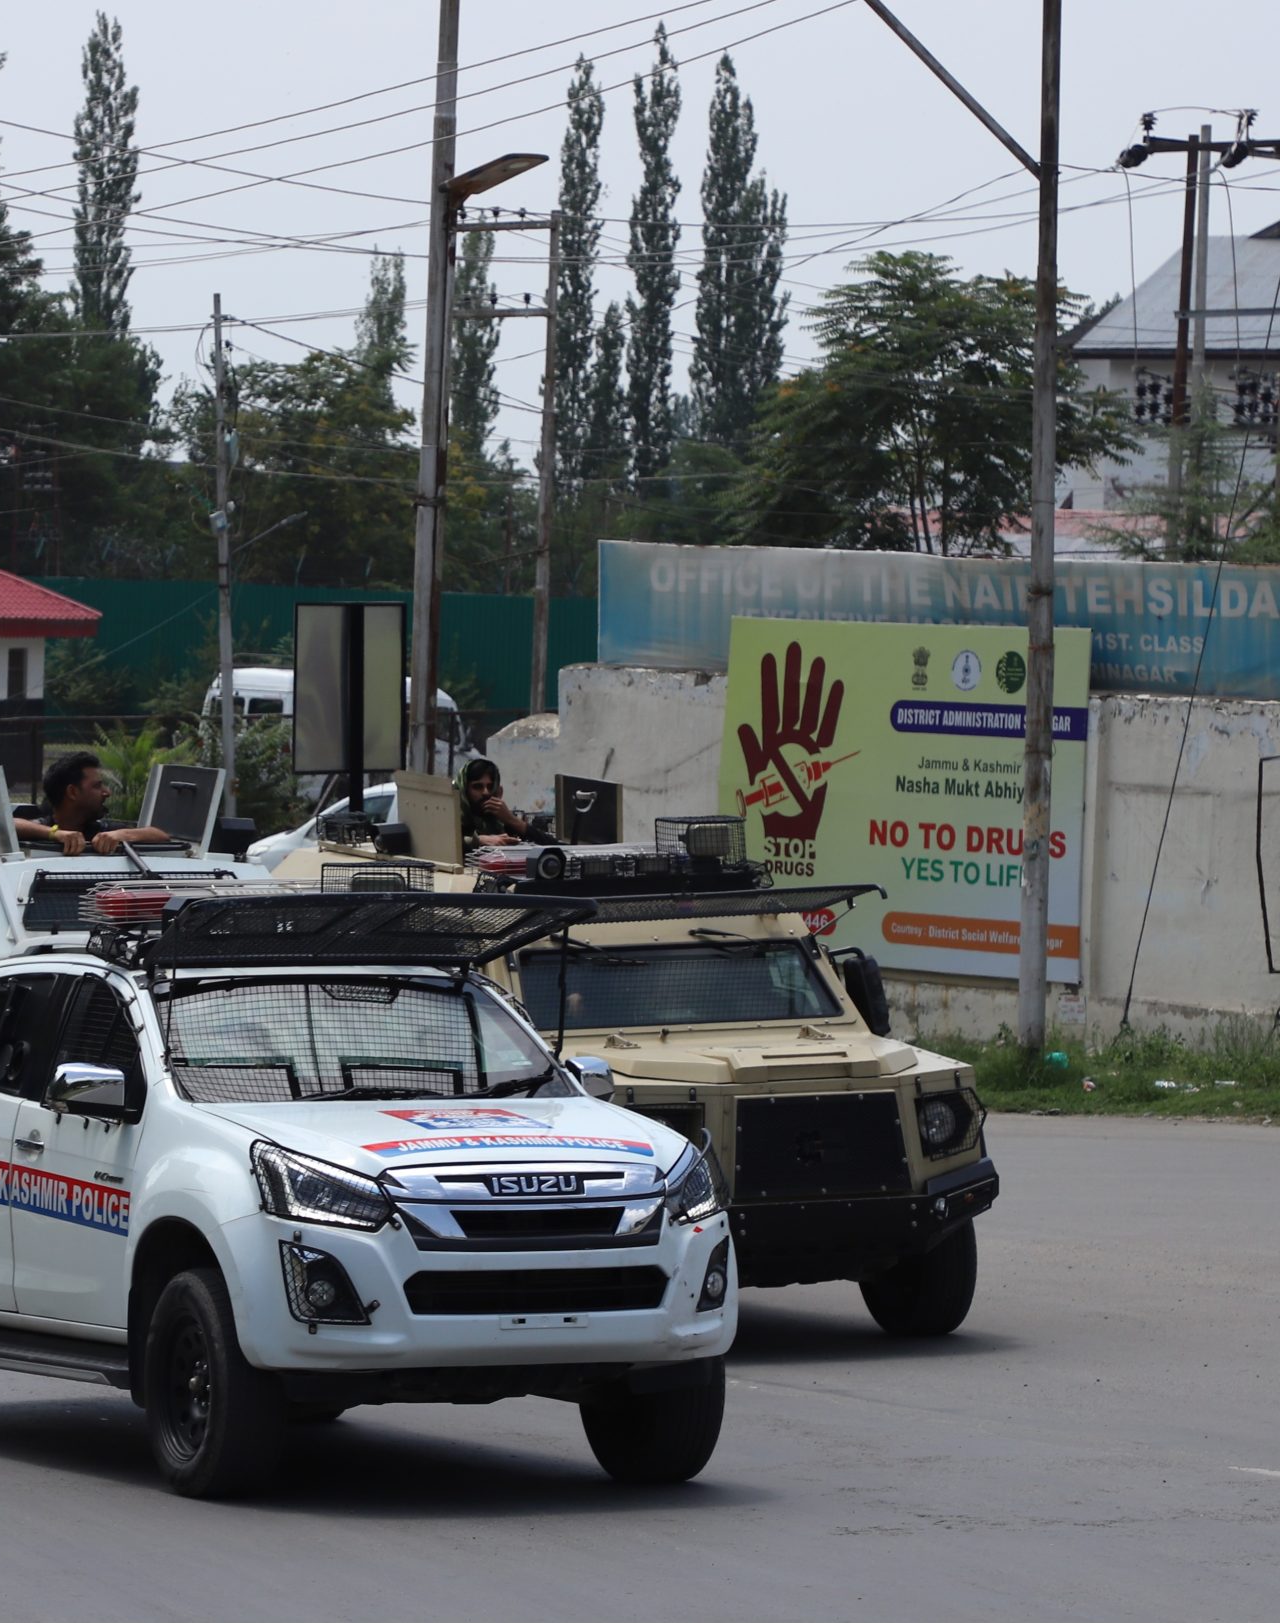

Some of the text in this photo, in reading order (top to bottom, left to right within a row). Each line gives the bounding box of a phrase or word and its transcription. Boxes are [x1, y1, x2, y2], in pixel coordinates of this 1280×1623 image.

[650, 558, 783, 597] OFFICE
[797, 560, 846, 601] OF
[860, 564, 932, 606] THE
[1139, 634, 1204, 654] CLASS
[896, 707, 941, 726] DISTRICT
[942, 709, 1021, 730] ADMINISTRATION
[917, 756, 1022, 774] Jammu & Kashmir
[895, 775, 940, 795] Nasha
[944, 777, 980, 798] Mukt
[764, 836, 817, 859] STOP
[869, 819, 1067, 859] NO TO DRUS
[764, 859, 815, 877] DRUGS
[901, 856, 1024, 888] YES TO LIF
[928, 925, 959, 940] District
[961, 929, 987, 943] Social
[397, 1135, 628, 1152] JAMMU & KASHMIR POLICE
[491, 1175, 577, 1193] ISUZU
[71, 1184, 130, 1231] POLICE
